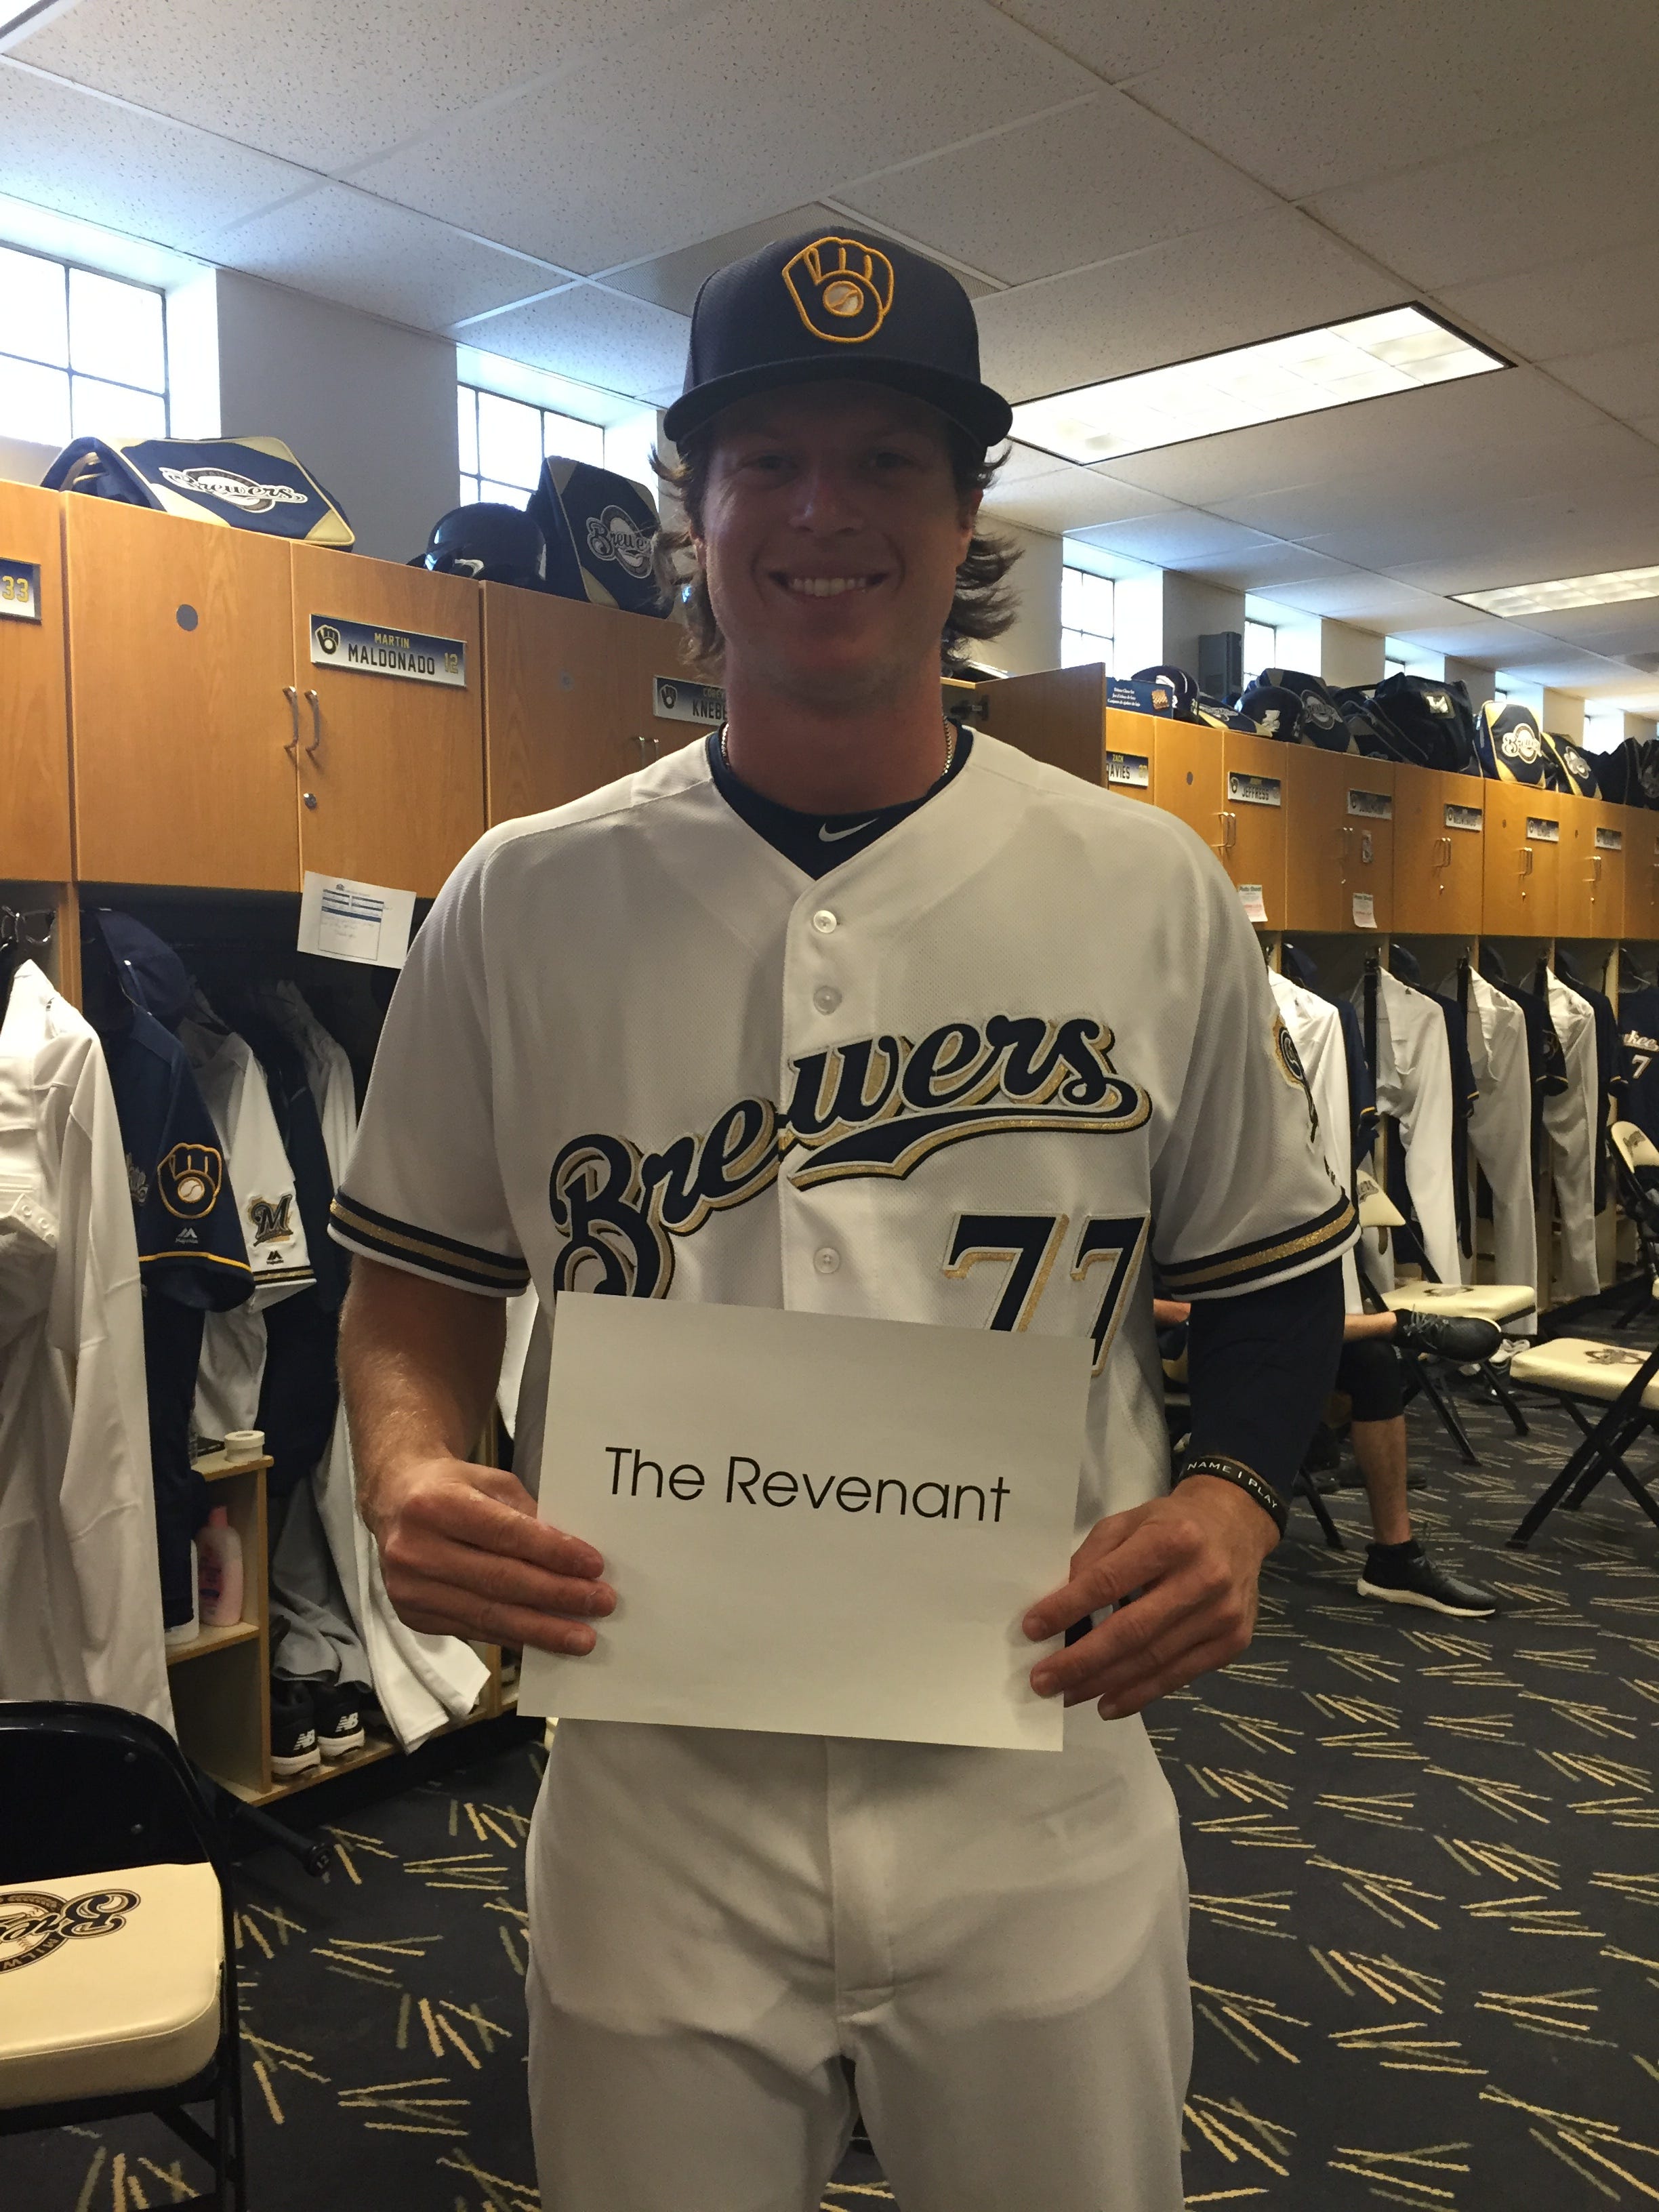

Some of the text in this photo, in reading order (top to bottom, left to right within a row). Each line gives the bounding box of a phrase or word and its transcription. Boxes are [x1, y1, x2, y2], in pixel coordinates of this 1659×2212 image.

[586, 517, 653, 561] Brewe
[2, 575, 29, 603] 33
[348, 643, 435, 676] MALDONADO
[374, 632, 410, 649] MARTIN
[445, 652, 458, 674] 12
[692, 699, 727, 720] KNEBE
[549, 1014, 1153, 1300] Brewers
[942, 1212, 1149, 1378] 77
[605, 1446, 1010, 1522] The Revenant
[1187, 1460, 1231, 1473] NAME
[1248, 1477, 1278, 1509] PLAY
